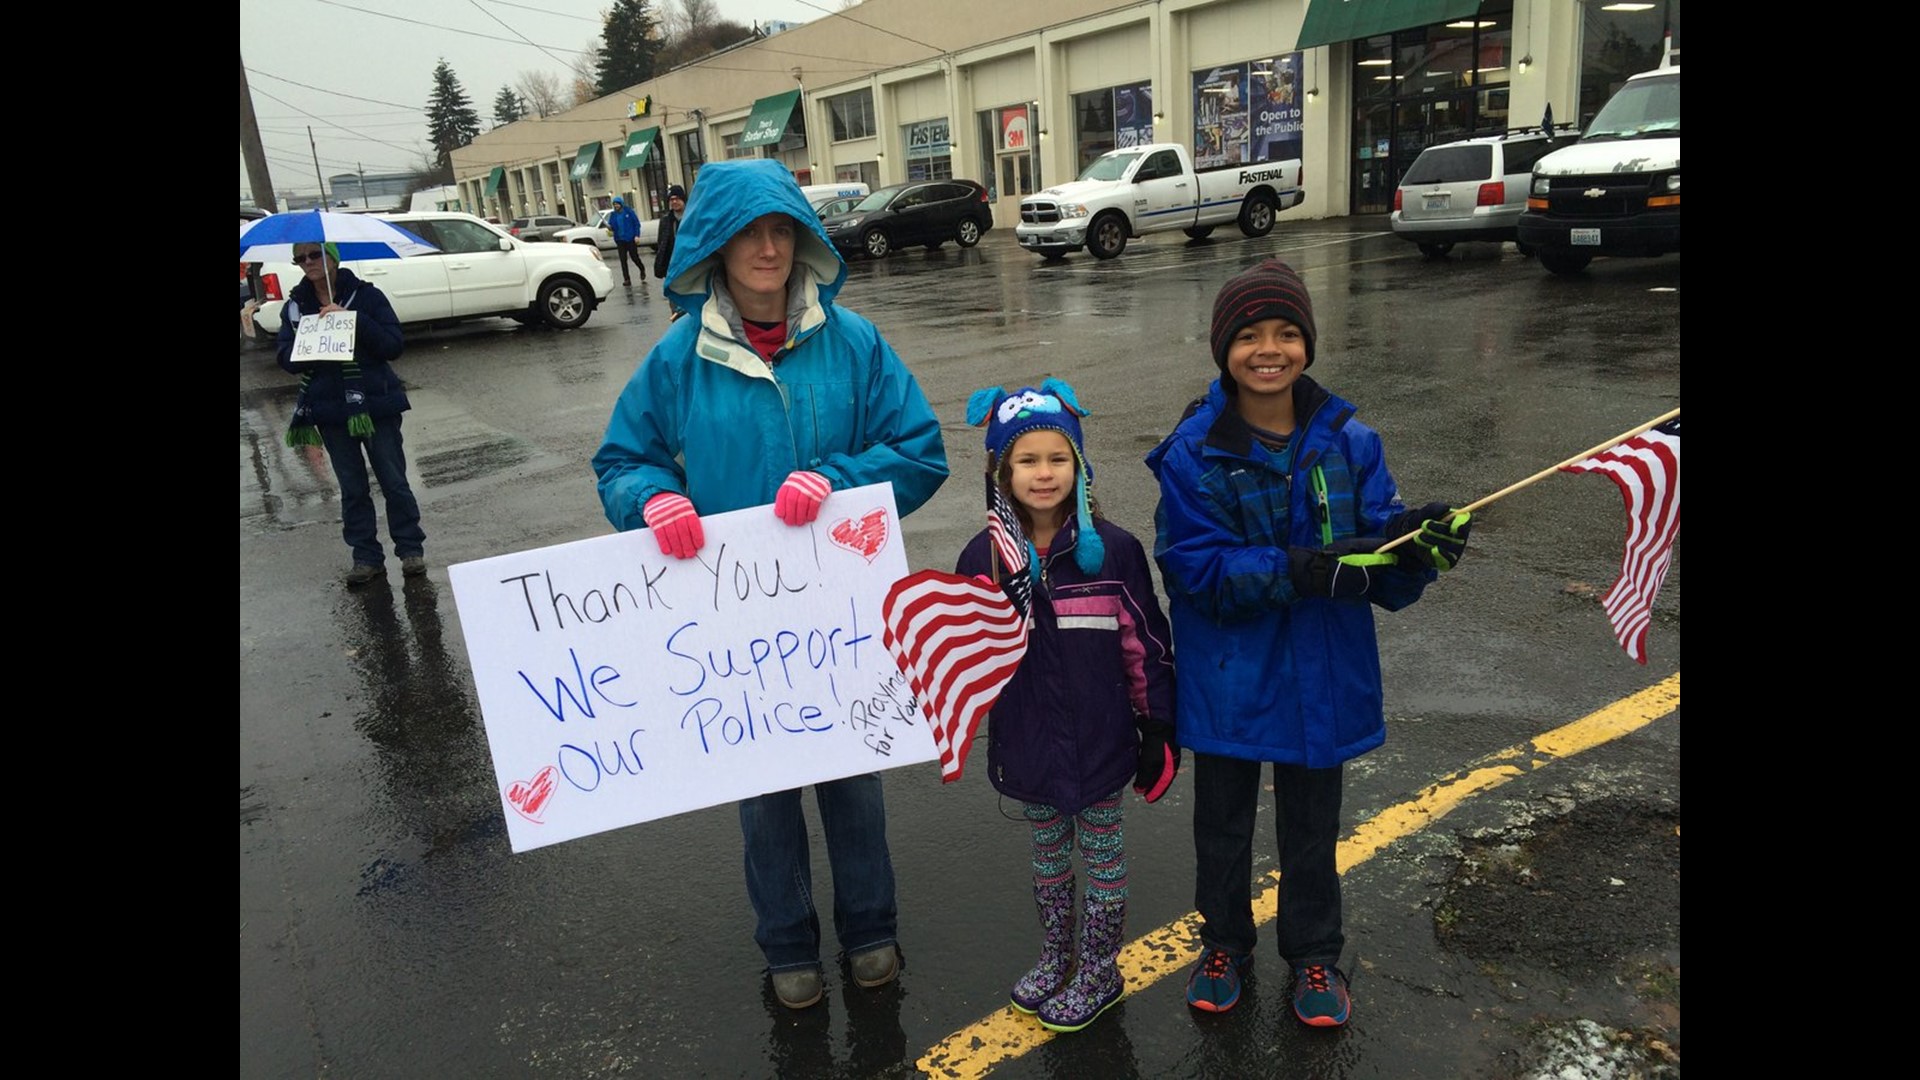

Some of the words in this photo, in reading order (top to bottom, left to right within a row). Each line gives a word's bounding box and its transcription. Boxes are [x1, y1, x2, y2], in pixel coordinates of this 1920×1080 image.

[1260, 110, 1287, 123] Open
[1290, 108, 1301, 118] to
[763, 127, 779, 139] Shop
[1008, 129, 1024, 148] 3M
[1256, 125, 1272, 136] the
[1274, 121, 1304, 133] Public
[1239, 169, 1283, 185] FASTENAL
[300, 317, 319, 335] God
[324, 314, 354, 331] Bless
[297, 340, 312, 355] the
[318, 334, 353, 353] Blue!
[500, 561, 673, 632] Thank
[696, 524, 823, 611] You!
[518, 648, 638, 722] We
[666, 597, 873, 696] Support
[681, 673, 846, 754] Police!
[863, 726, 895, 756] for
